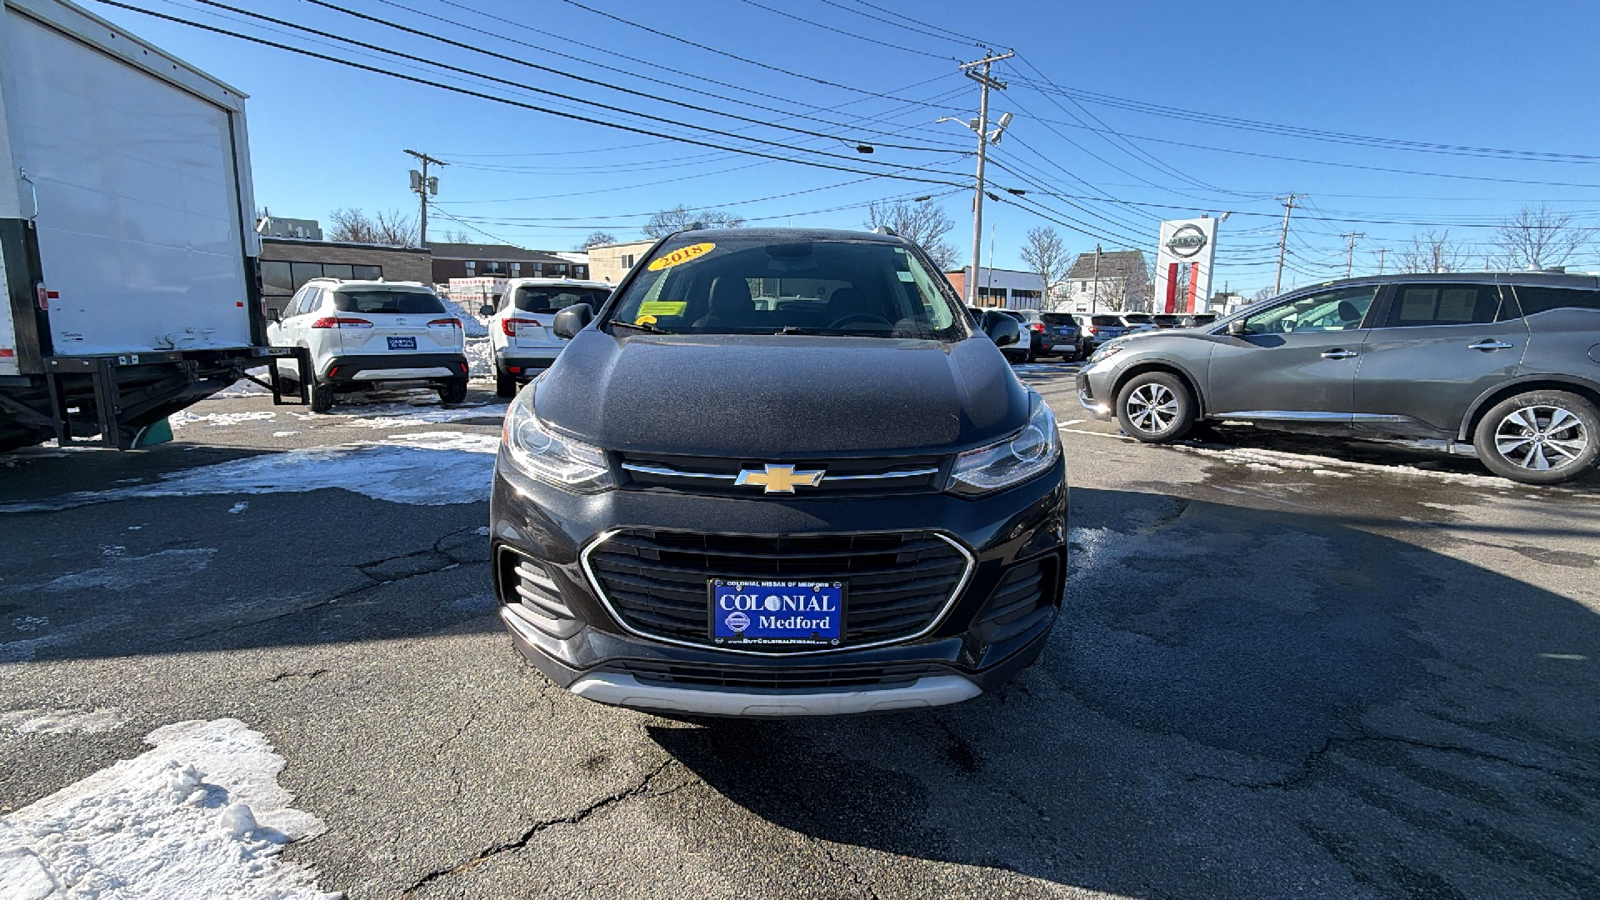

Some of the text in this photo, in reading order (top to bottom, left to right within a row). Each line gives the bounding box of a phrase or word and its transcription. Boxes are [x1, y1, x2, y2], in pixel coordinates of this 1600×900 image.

[660, 245, 703, 267] 2018
[719, 594, 836, 612] COLONIAL
[758, 615, 831, 630] Medford
